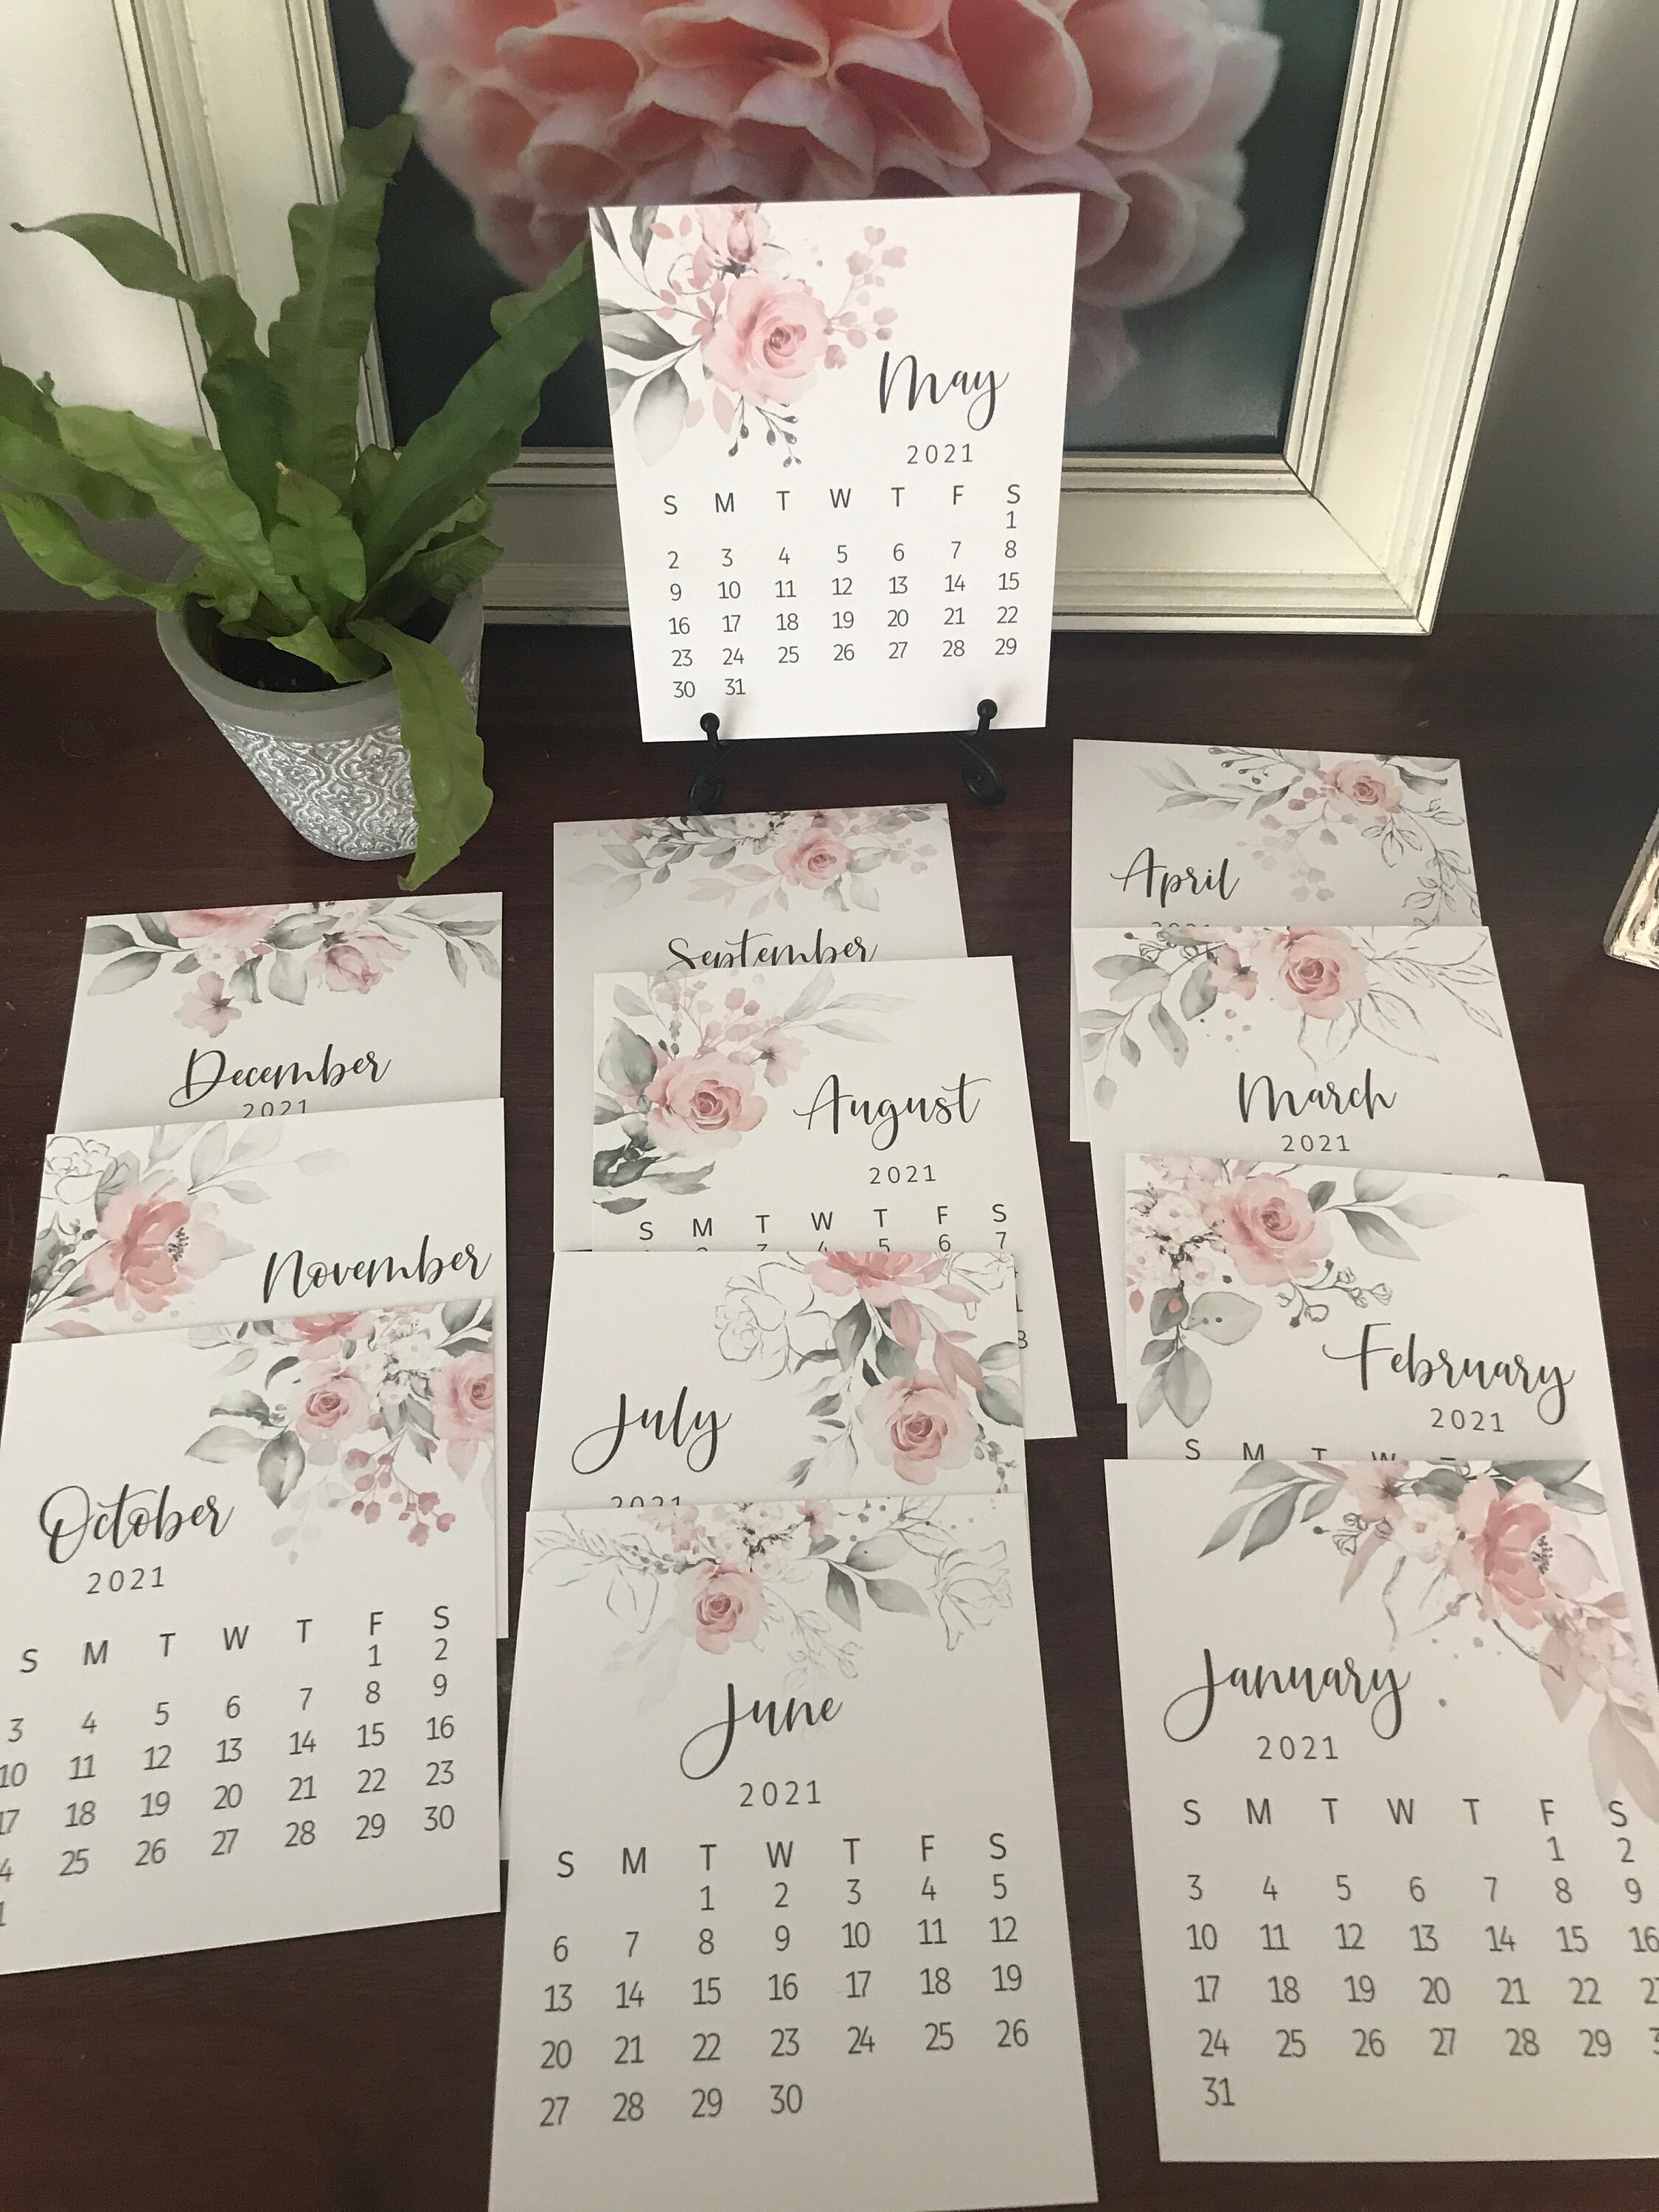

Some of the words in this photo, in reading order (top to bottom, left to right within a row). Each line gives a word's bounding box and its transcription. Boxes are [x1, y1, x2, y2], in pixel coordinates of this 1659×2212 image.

[879, 350, 1009, 431] May
[907, 443, 973, 465] 2021
[663, 494, 678, 515] S
[714, 492, 734, 513] M
[776, 490, 790, 511] T
[829, 487, 852, 509] W
[891, 487, 905, 507] T
[953, 484, 964, 506] F
[1006, 484, 1020, 504] S
[1006, 510, 1017, 529] 1
[667, 550, 679, 569] 2
[721, 548, 733, 567] 3
[778, 546, 790, 565] 4
[837, 544, 848, 564] 5
[893, 543, 905, 562] 6
[951, 540, 961, 560] 7
[1004, 540, 1017, 559] 8
[669, 582, 682, 602] 9
[717, 580, 741, 599] 10
[774, 580, 797, 598] 11
[831, 577, 852, 596] 12
[888, 575, 908, 594] 13
[945, 574, 966, 593] 14
[998, 571, 1020, 591] 15
[671, 649, 693, 667] 23
[722, 647, 745, 666] 24
[777, 645, 799, 664] 25
[833, 643, 855, 661] 26
[888, 641, 908, 660] 27
[942, 639, 965, 658] 28
[994, 637, 1018, 655] 29
[672, 681, 696, 699] 30
[724, 678, 746, 696] 31
[1110, 846, 1240, 908] April
[168, 1043, 392, 1108] December
[793, 1072, 992, 1151] August
[1238, 1068, 1397, 1124] March
[1281, 1134, 1350, 1152] 2021
[869, 1164, 936, 1185] 2021
[639, 1221, 654, 1241] S
[692, 1217, 713, 1237] M
[755, 1214, 771, 1234] T
[810, 1211, 833, 1231] W
[873, 1208, 888, 1228] T
[936, 1206, 948, 1225] F
[992, 1203, 1007, 1222] S
[938, 1234, 951, 1253] 6
[995, 1231, 1006, 1250] 7
[262, 1234, 493, 1304] November
[1322, 1322, 1576, 1427] February
[571, 1385, 732, 1475] July
[1430, 1408, 1505, 1433] 2021
[1185, 1439, 1202, 1461] S
[1242, 1441, 1265, 1461] M
[38, 1483, 235, 1565] October
[86, 1565, 164, 1595] 2021
[19, 1648, 38, 1674] S
[83, 1639, 108, 1666] M
[159, 1632, 176, 1658] T
[223, 1624, 250, 1651] W
[296, 1618, 313, 1644] T
[369, 1610, 384, 1636] F
[434, 1605, 450, 1630] S
[368, 1644, 382, 1667] 1
[434, 1638, 448, 1661] 2
[7, 1717, 24, 1743] 3
[81, 1711, 97, 1734] 4
[154, 1701, 170, 1726] 5
[226, 1695, 240, 1719] 6
[299, 1687, 313, 1711] 7
[365, 1680, 380, 1704] 8
[433, 1673, 448, 1697] 9
[1163, 1648, 1411, 1743] January
[69, 1754, 96, 1781] 11
[143, 1745, 172, 1771] 12
[216, 1737, 243, 1764] 13
[289, 1730, 317, 1756] 14
[357, 1722, 385, 1748] 15
[426, 1714, 455, 1741] 16
[679, 1683, 844, 1781] June
[1256, 1735, 1339, 1761] 2021
[740, 1779, 821, 1808] 2021
[1183, 1798, 1201, 1826] S
[1246, 1798, 1272, 1825] M
[1321, 1798, 1339, 1825] T
[1386, 1798, 1414, 1825] W
[1462, 1798, 1480, 1826] T
[1540, 1798, 1554, 1826] F
[1607, 1800, 1627, 1828] S
[59, 1848, 90, 1877] 25
[134, 1837, 167, 1867] 26
[210, 1828, 240, 1857] 27
[284, 1820, 316, 1848] 28
[355, 1813, 386, 1840] 29
[423, 1804, 455, 1832] 30
[557, 1850, 574, 1879] S
[622, 1846, 647, 1875] M
[699, 1843, 717, 1871] T
[765, 1840, 793, 1868] W
[842, 1837, 861, 1865] T
[921, 1834, 935, 1863] F
[989, 1832, 1007, 1860] S
[1546, 1836, 1565, 1862] 1
[1617, 1837, 1635, 1863] 2
[700, 1885, 715, 1911] 1
[774, 1882, 789, 1908] 2
[846, 1878, 861, 1905] 3
[921, 1876, 937, 1902] 4
[992, 1873, 1007, 1900] 5
[1186, 1874, 1203, 1901] 3
[1262, 1875, 1279, 1902] 4
[1336, 1874, 1352, 1902] 5
[1409, 1876, 1426, 1903] 6
[1483, 1876, 1498, 1902] 7
[1554, 1877, 1573, 1905] 8
[1624, 1877, 1642, 1905] 9
[553, 1935, 569, 1963] 6
[625, 1930, 640, 1958] 7
[698, 1927, 714, 1955] 8
[775, 1924, 790, 1952] 9
[841, 1921, 871, 1949] 10
[917, 1918, 947, 1945] 11
[989, 1915, 1018, 1943] 12
[1186, 1923, 1218, 1951] 10
[1259, 1923, 1290, 1951] 11
[1335, 1922, 1366, 1950] 12
[1409, 1924, 1439, 1952] 13
[1484, 1924, 1516, 1952] 14
[1556, 1925, 1588, 1953] 15
[1628, 1926, 1659, 1953] 16
[540, 2039, 573, 2070] 20
[613, 2034, 644, 2065] 21
[692, 2032, 721, 2062] 22
[771, 2027, 800, 2057] 23
[846, 2025, 876, 2055] 24
[924, 2021, 954, 2051] 25
[995, 2018, 1029, 2048] 26
[1198, 2028, 1230, 2058] 24
[1276, 2028, 1307, 2059] 25
[1352, 2028, 1385, 2058] 26
[1429, 2027, 1456, 2057] 27
[1506, 2027, 1540, 2057] 28
[1579, 2028, 1612, 2058] 29
[539, 2096, 570, 2128] 27
[612, 2091, 644, 2123] 28
[691, 2087, 723, 2118] 29
[770, 2084, 803, 2115] 30
[1202, 2076, 1236, 2107] 31
